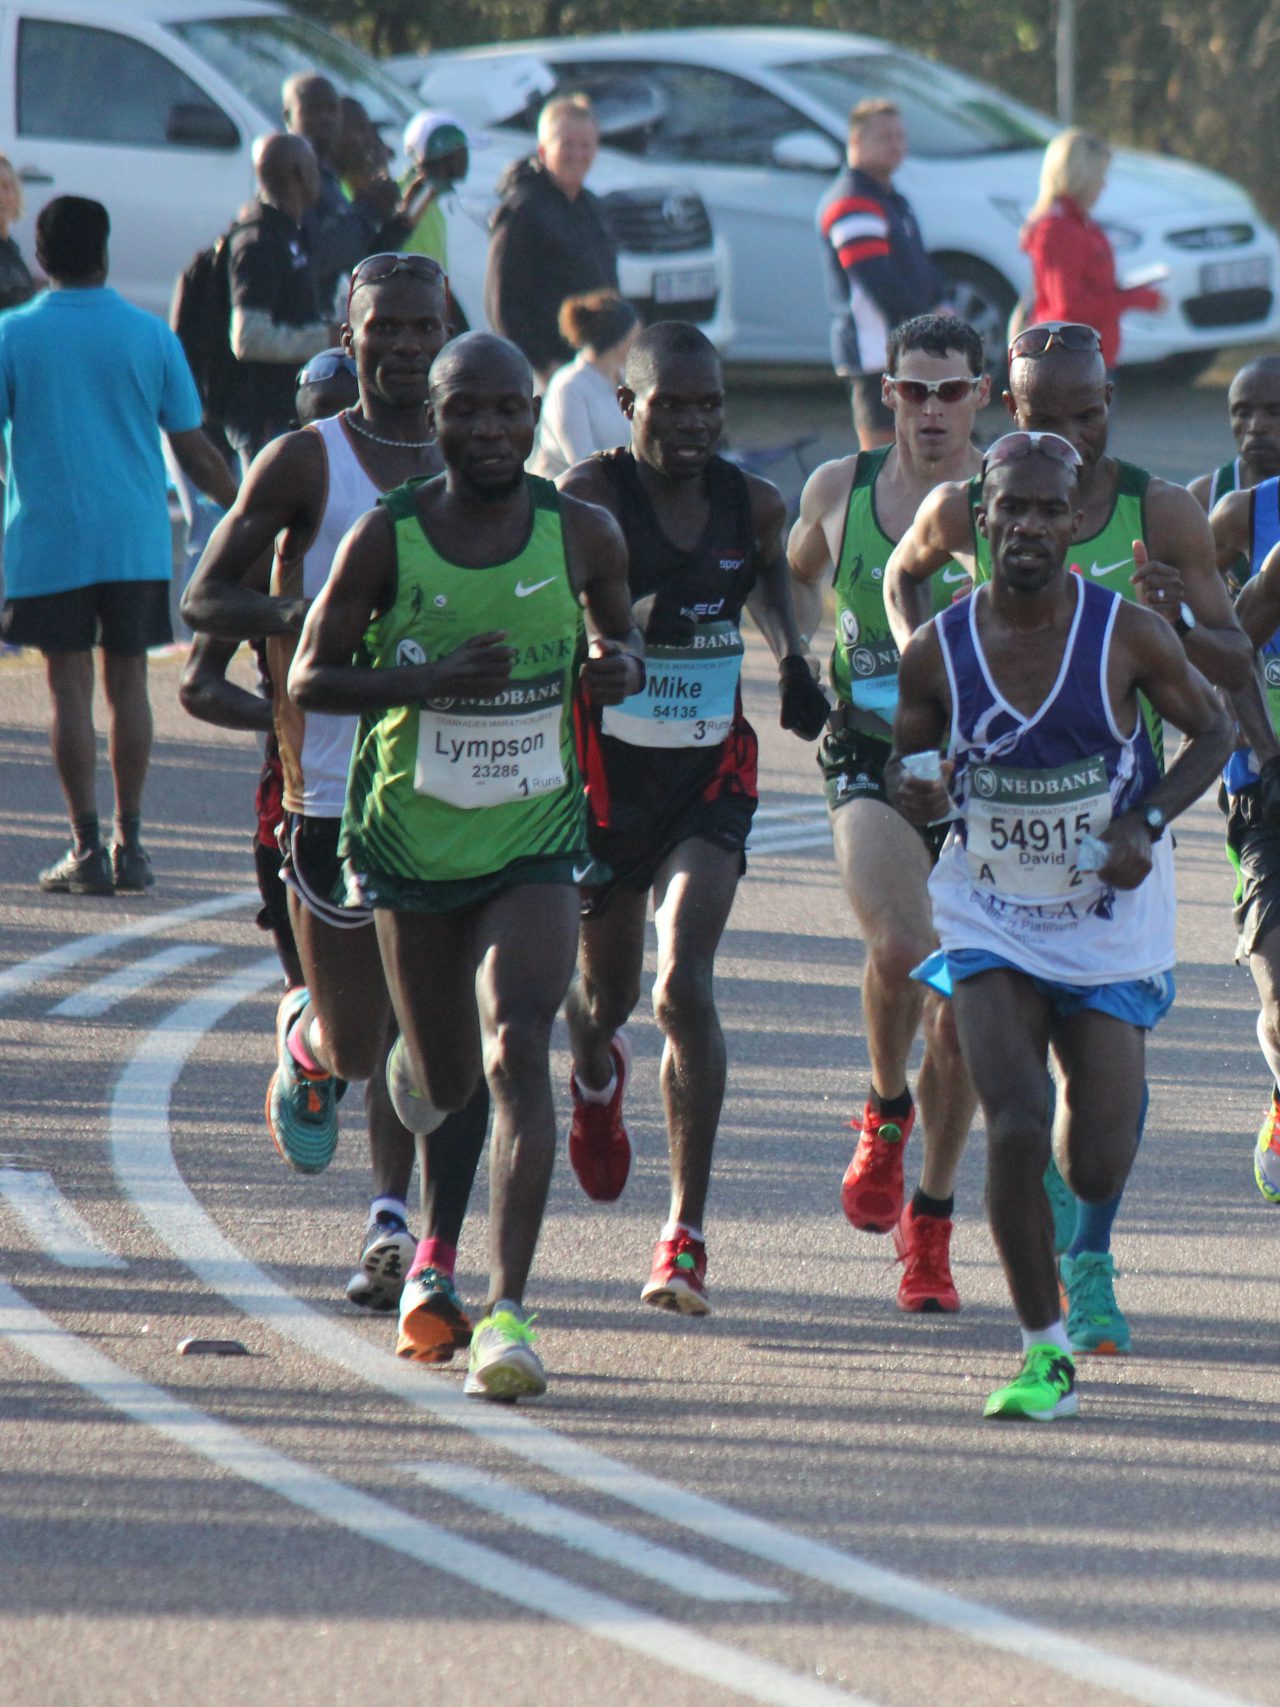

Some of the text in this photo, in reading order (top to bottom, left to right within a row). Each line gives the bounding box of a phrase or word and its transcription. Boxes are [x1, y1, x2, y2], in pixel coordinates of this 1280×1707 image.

[648, 675, 702, 699] Mike
[652, 705, 698, 719] 54135
[694, 720, 730, 740] 3 Runs
[435, 731, 544, 763] Lympson
[472, 764, 520, 778] 23286
[1000, 767, 1102, 795] NEDBANK
[518, 776, 562, 798] 1 Runs
[990, 812, 1091, 852] 54915
[1018, 852, 1065, 865] David
[979, 863, 996, 885] A
